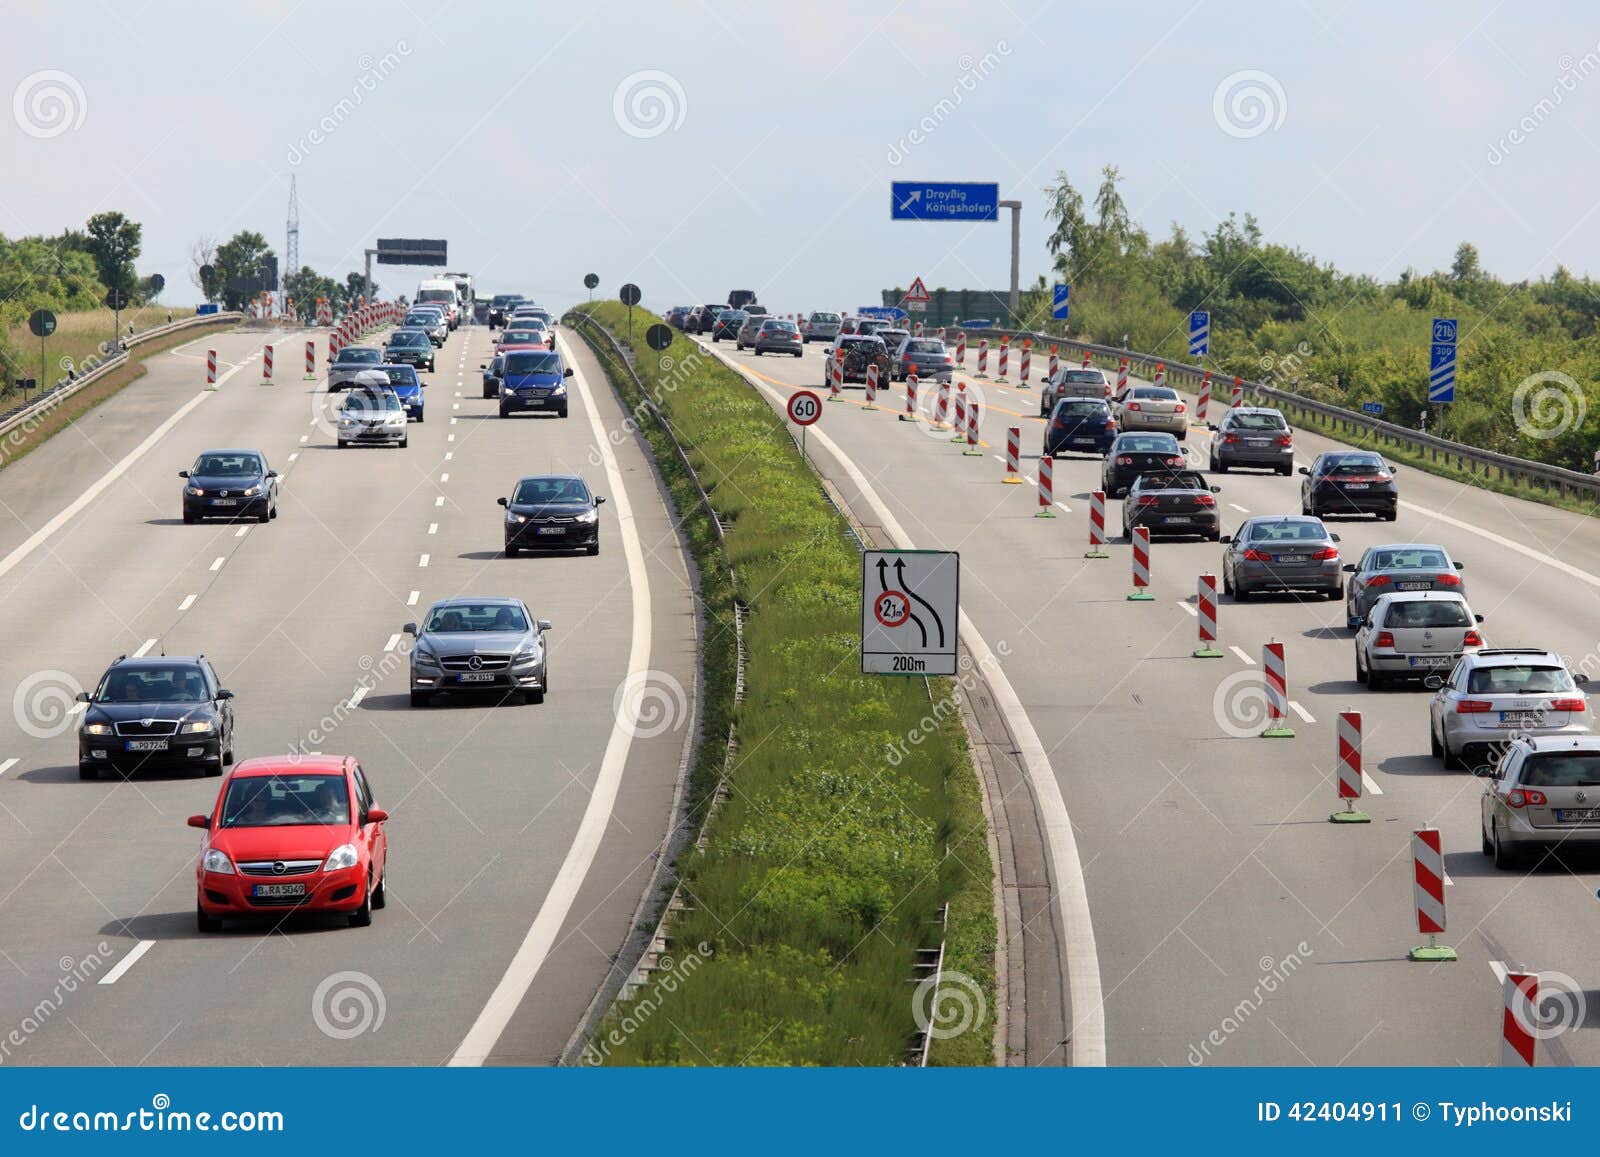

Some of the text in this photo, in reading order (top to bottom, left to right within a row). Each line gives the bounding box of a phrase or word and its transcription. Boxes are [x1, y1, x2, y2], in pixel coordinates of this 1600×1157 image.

[926, 189, 967, 200] Droyßig
[926, 201, 992, 214] Königshofen
[1436, 326, 1454, 337] 21b
[1436, 346, 1452, 355] 300
[795, 400, 815, 417] 60
[893, 656, 925, 671] 200m
